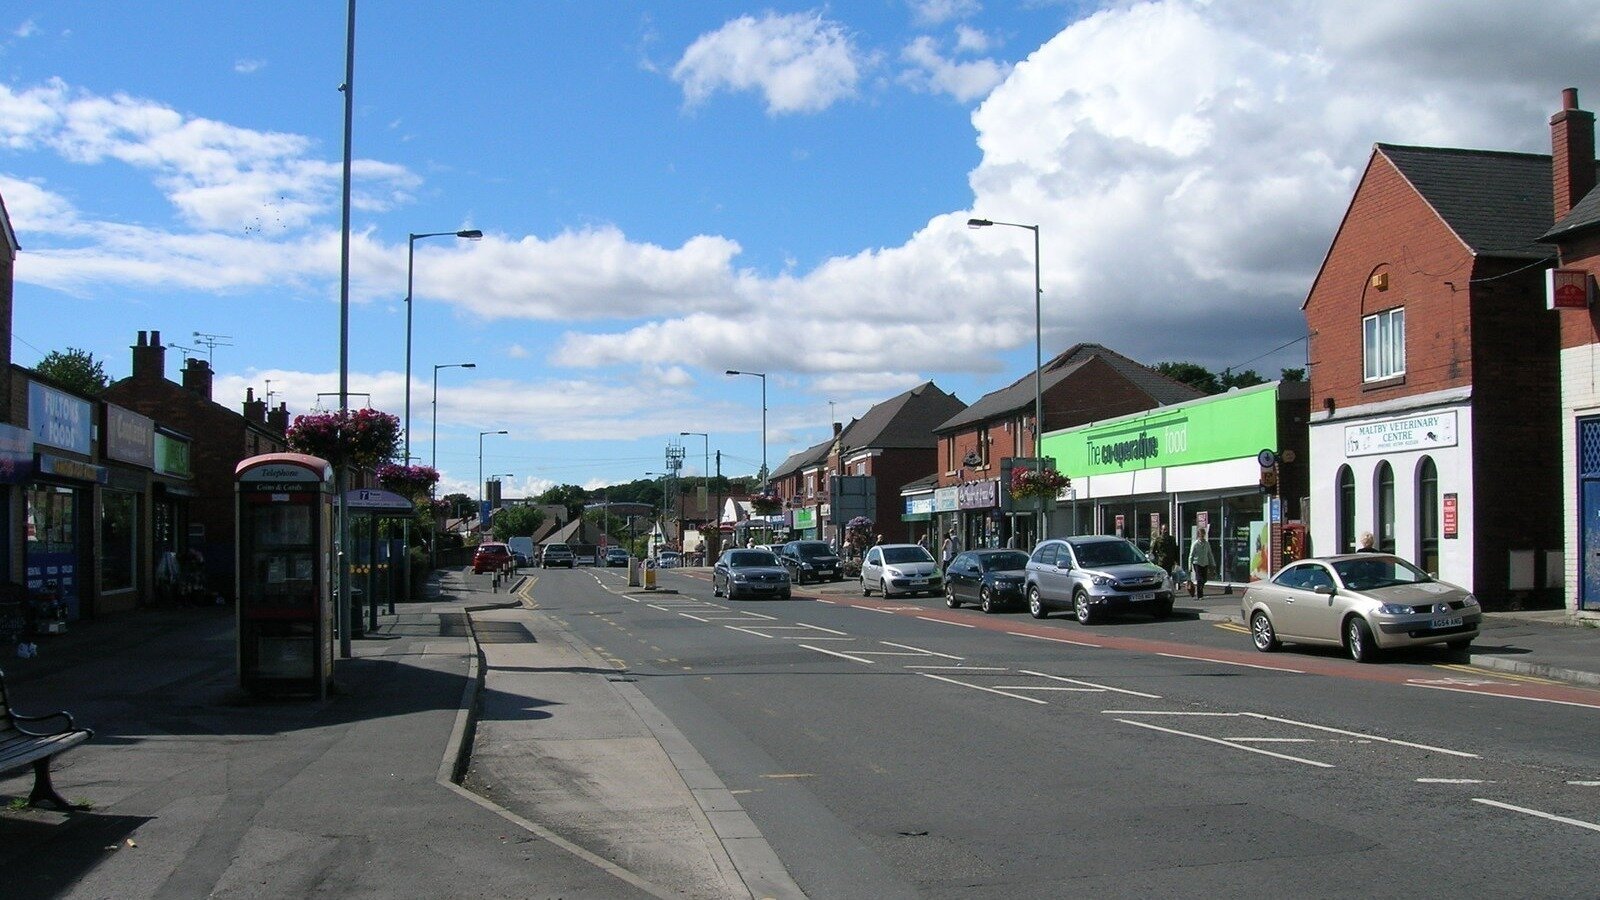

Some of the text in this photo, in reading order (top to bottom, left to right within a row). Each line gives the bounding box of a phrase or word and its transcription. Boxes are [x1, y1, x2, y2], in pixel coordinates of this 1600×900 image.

[1359, 416, 1439, 435] MALTBY VETERINARY
[1382, 430, 1413, 442] CENTRE
[1086, 422, 1187, 468] The co-operative food
[261, 468, 299, 478] Telephone
